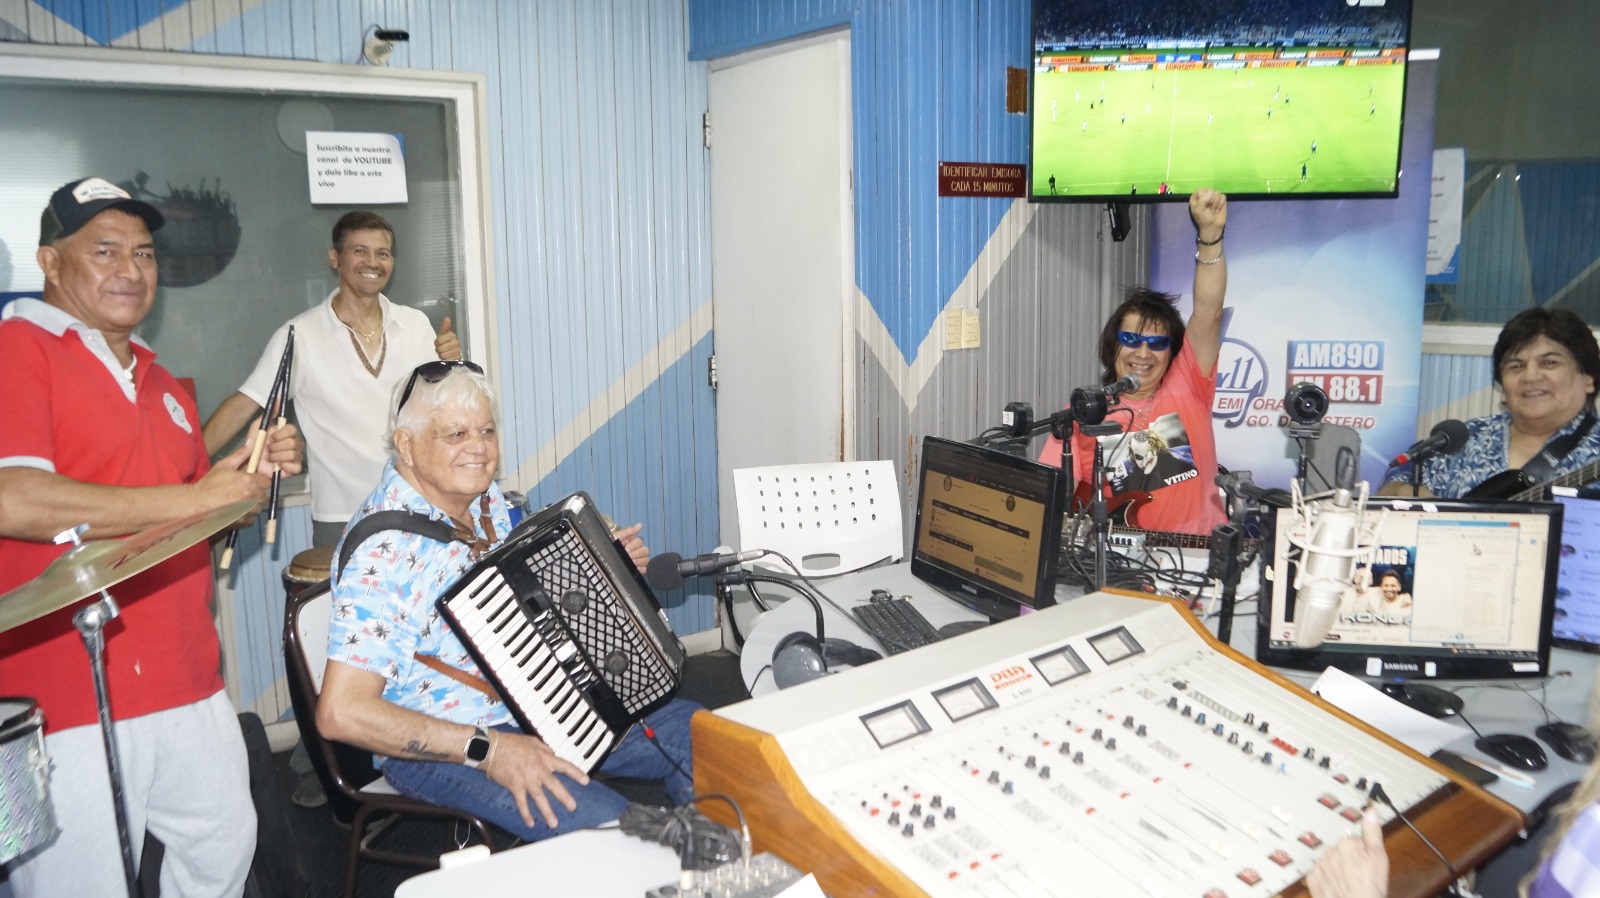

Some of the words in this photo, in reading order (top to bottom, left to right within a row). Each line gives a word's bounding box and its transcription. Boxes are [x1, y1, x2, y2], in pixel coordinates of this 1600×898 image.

[316, 144, 353, 153] Suscribite
[362, 146, 391, 154] nuestro
[342, 156, 352, 164] de
[354, 157, 393, 165] YOUTUBE
[324, 169, 342, 177] dale
[343, 169, 358, 177] like
[943, 165, 988, 178] IDENTIFICAR
[991, 167, 1022, 179] EMISORA
[318, 180, 336, 188] vivo
[950, 180, 971, 192] CADA
[972, 181, 981, 192] 15
[983, 181, 1014, 193] MINUTOS
[1293, 342, 1380, 369] AM890
[1328, 375, 1378, 402] 88.1
[1321, 416, 1377, 429] STERO
[1163, 469, 1198, 486] VITINO
[1383, 662, 1419, 672] SAMSUNG
